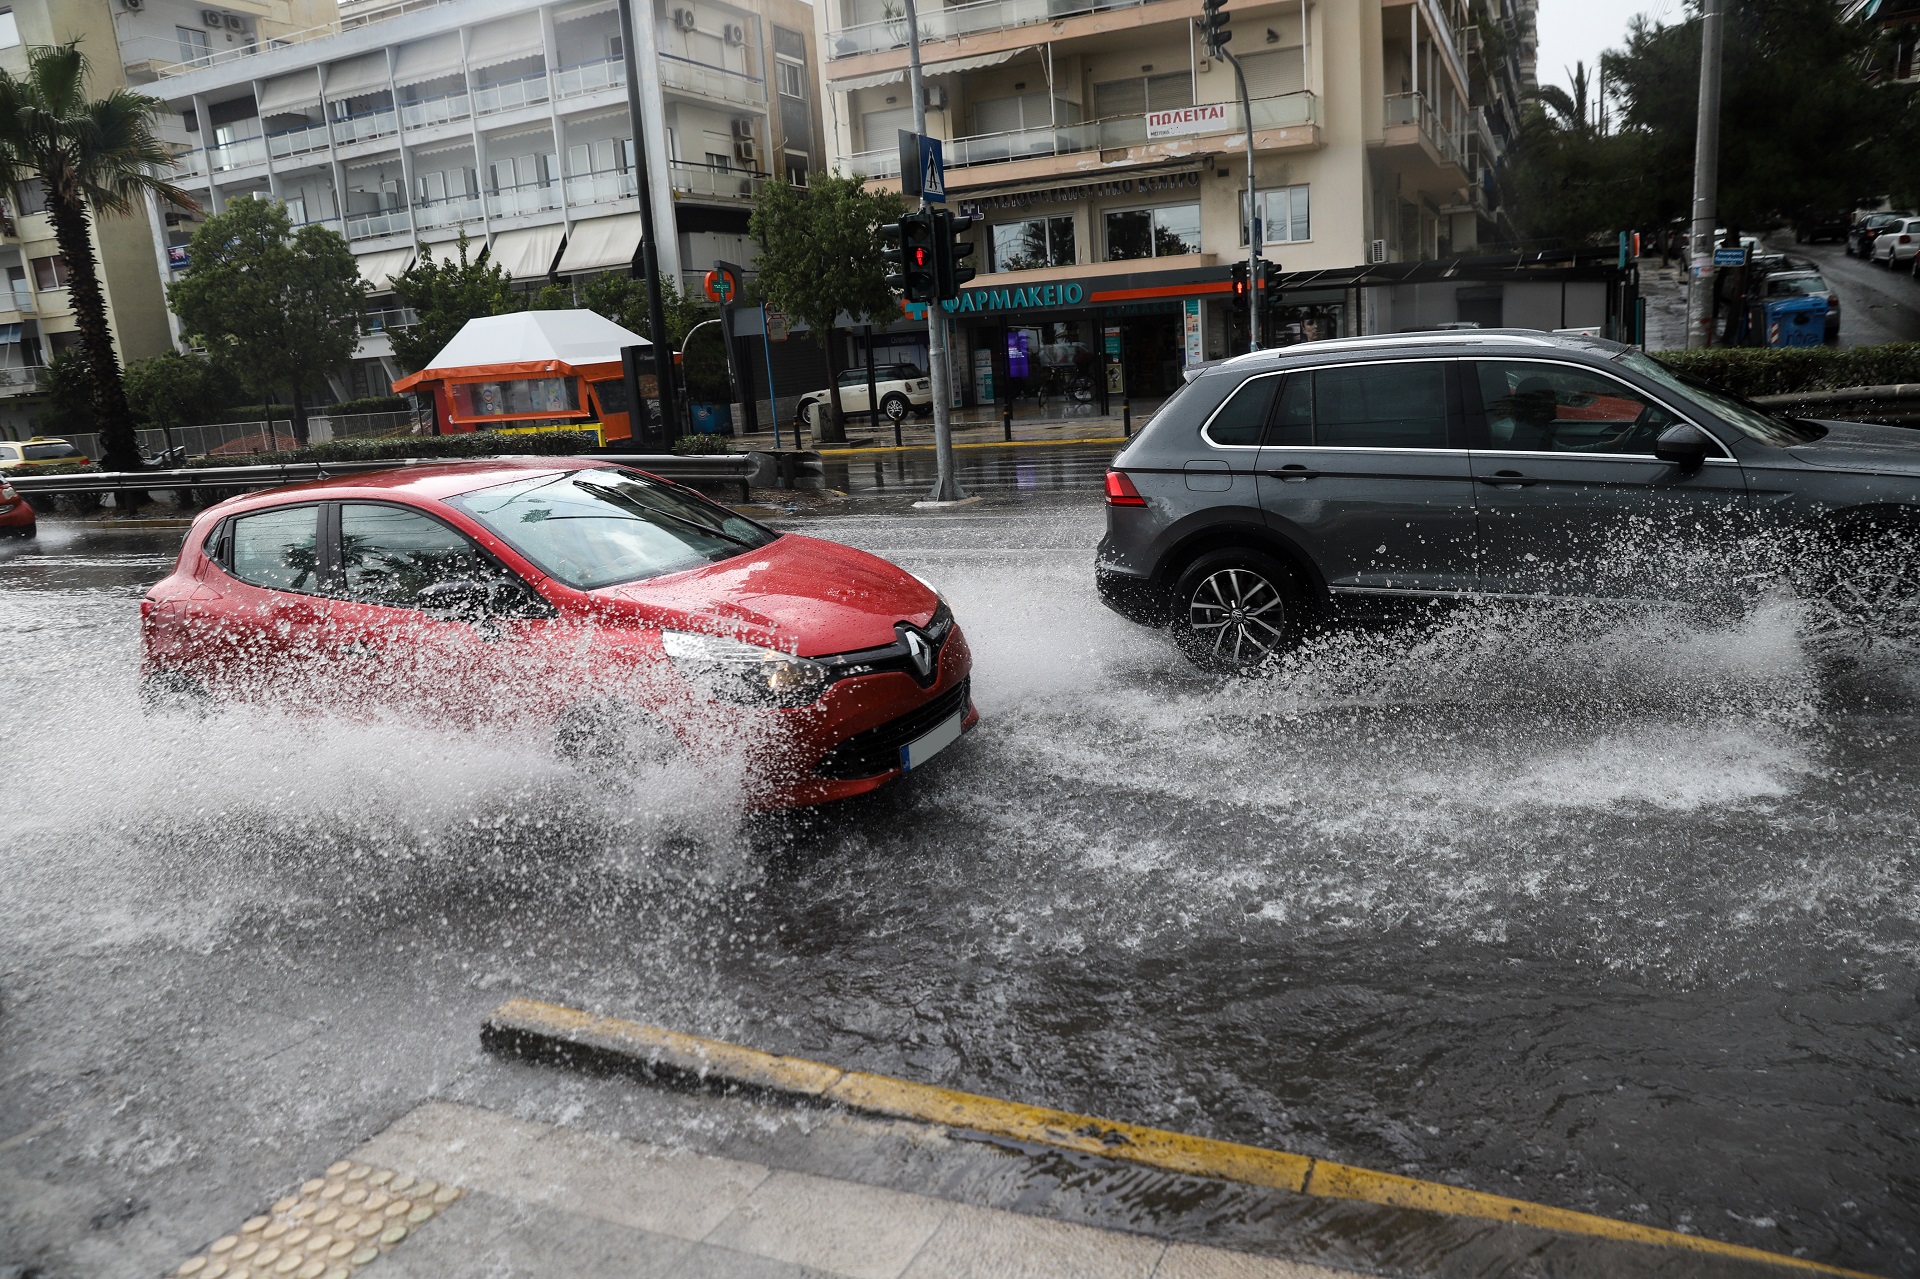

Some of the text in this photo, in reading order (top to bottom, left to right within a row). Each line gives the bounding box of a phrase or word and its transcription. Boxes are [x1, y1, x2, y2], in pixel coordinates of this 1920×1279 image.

[1149, 106, 1224, 126] ΠΩΛΕΙΤΑΙ
[1138, 172, 1199, 193] ΚΕΝΤΡΟ
[890, 335, 927, 344] Osteoflex
